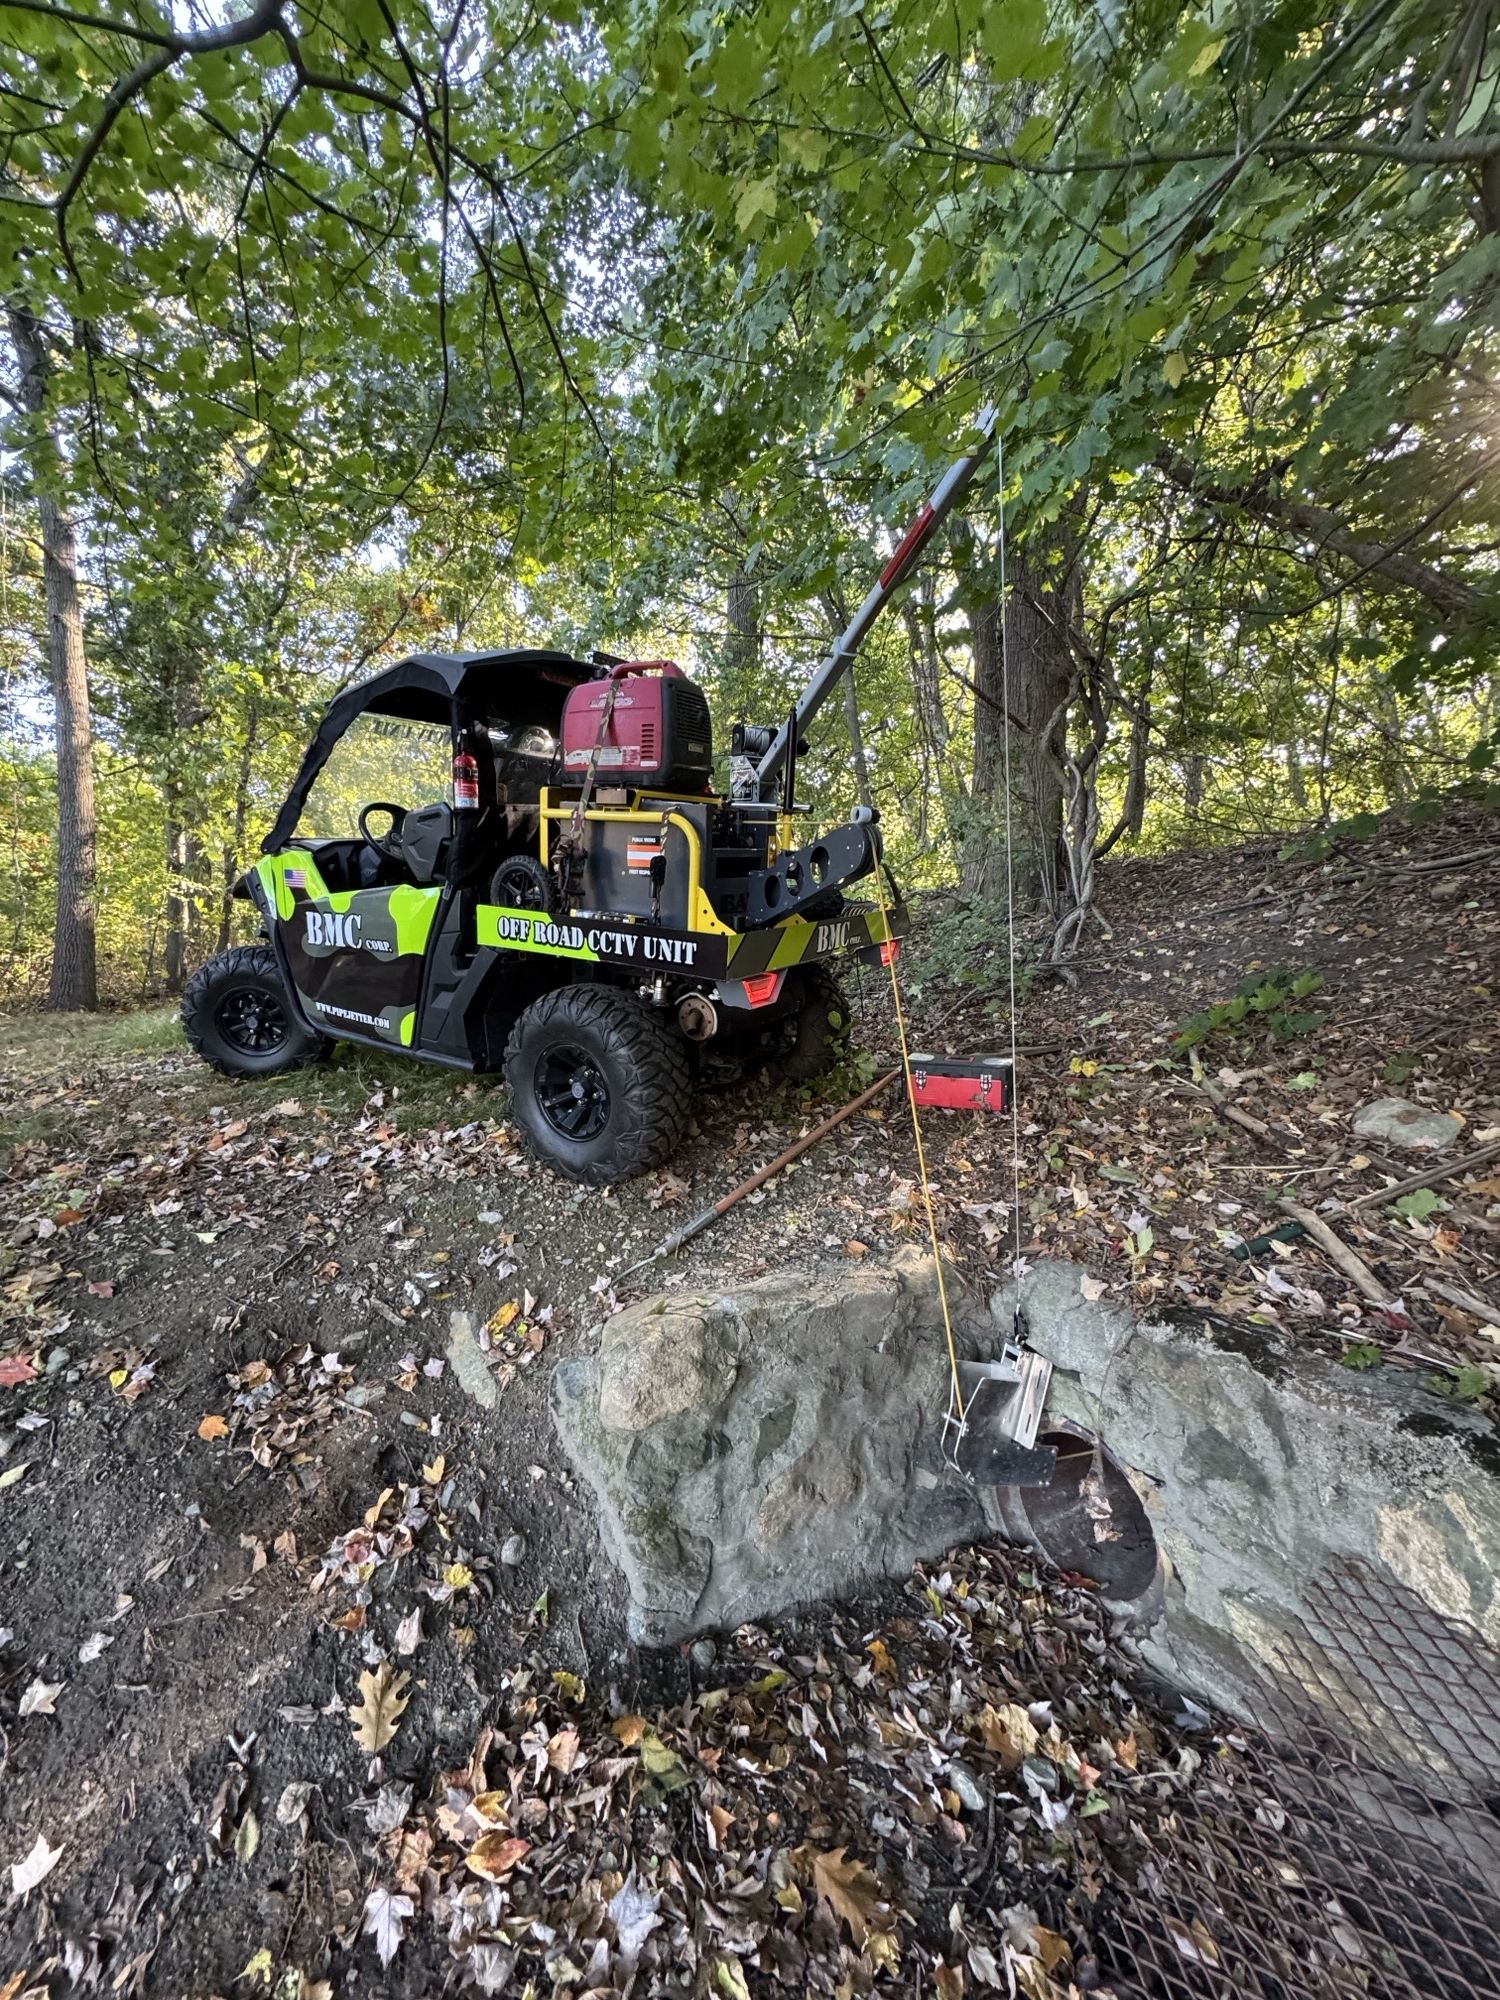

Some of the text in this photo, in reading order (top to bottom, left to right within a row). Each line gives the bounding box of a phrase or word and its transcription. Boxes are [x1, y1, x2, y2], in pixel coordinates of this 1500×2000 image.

[599, 691, 625, 699] HODA
[305, 911, 393, 953] BMC CORP.
[498, 917, 698, 966] OFF ROAD CCTV UNIT
[816, 921, 851, 953] BMC
[315, 1001, 390, 1029] WWW.PIPEJETTER.COM
